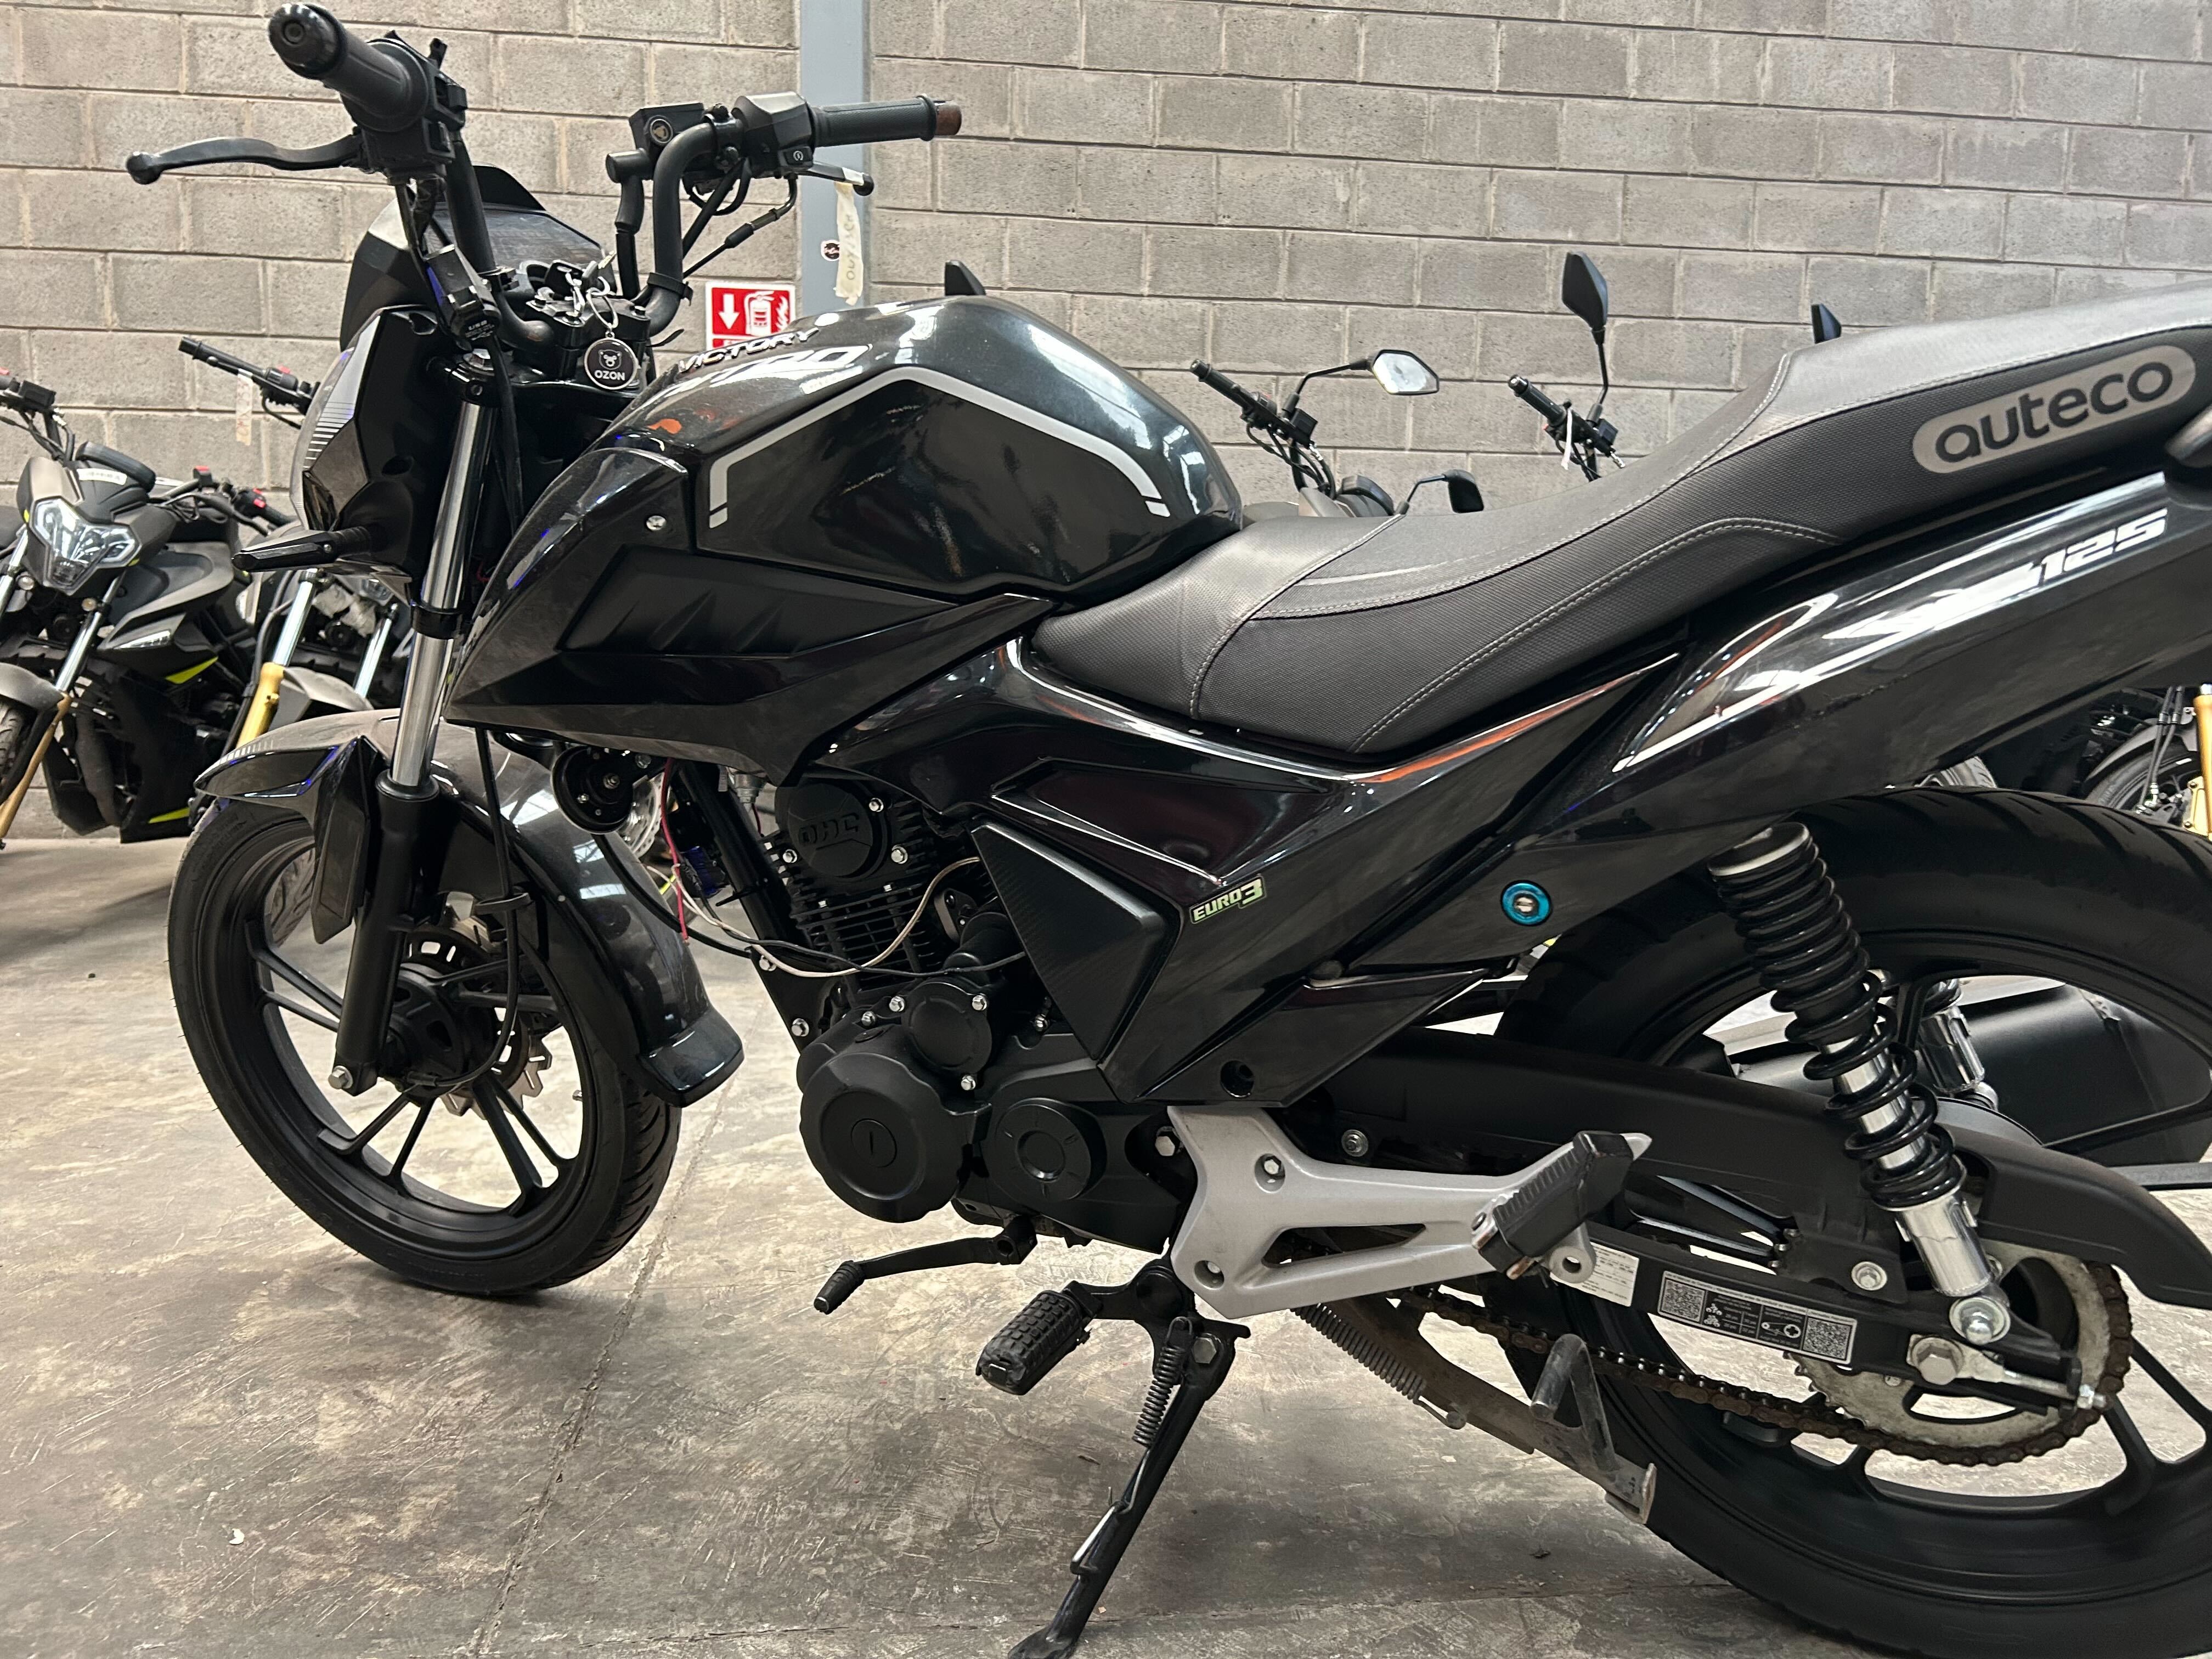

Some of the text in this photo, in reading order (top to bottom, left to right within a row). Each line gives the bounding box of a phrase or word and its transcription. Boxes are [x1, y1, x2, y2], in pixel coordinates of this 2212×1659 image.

[594, 370, 625, 381] OZON
[678, 328, 819, 373] VICTORY
[1935, 362, 2173, 463] auteco
[2040, 507, 2168, 580] 125
